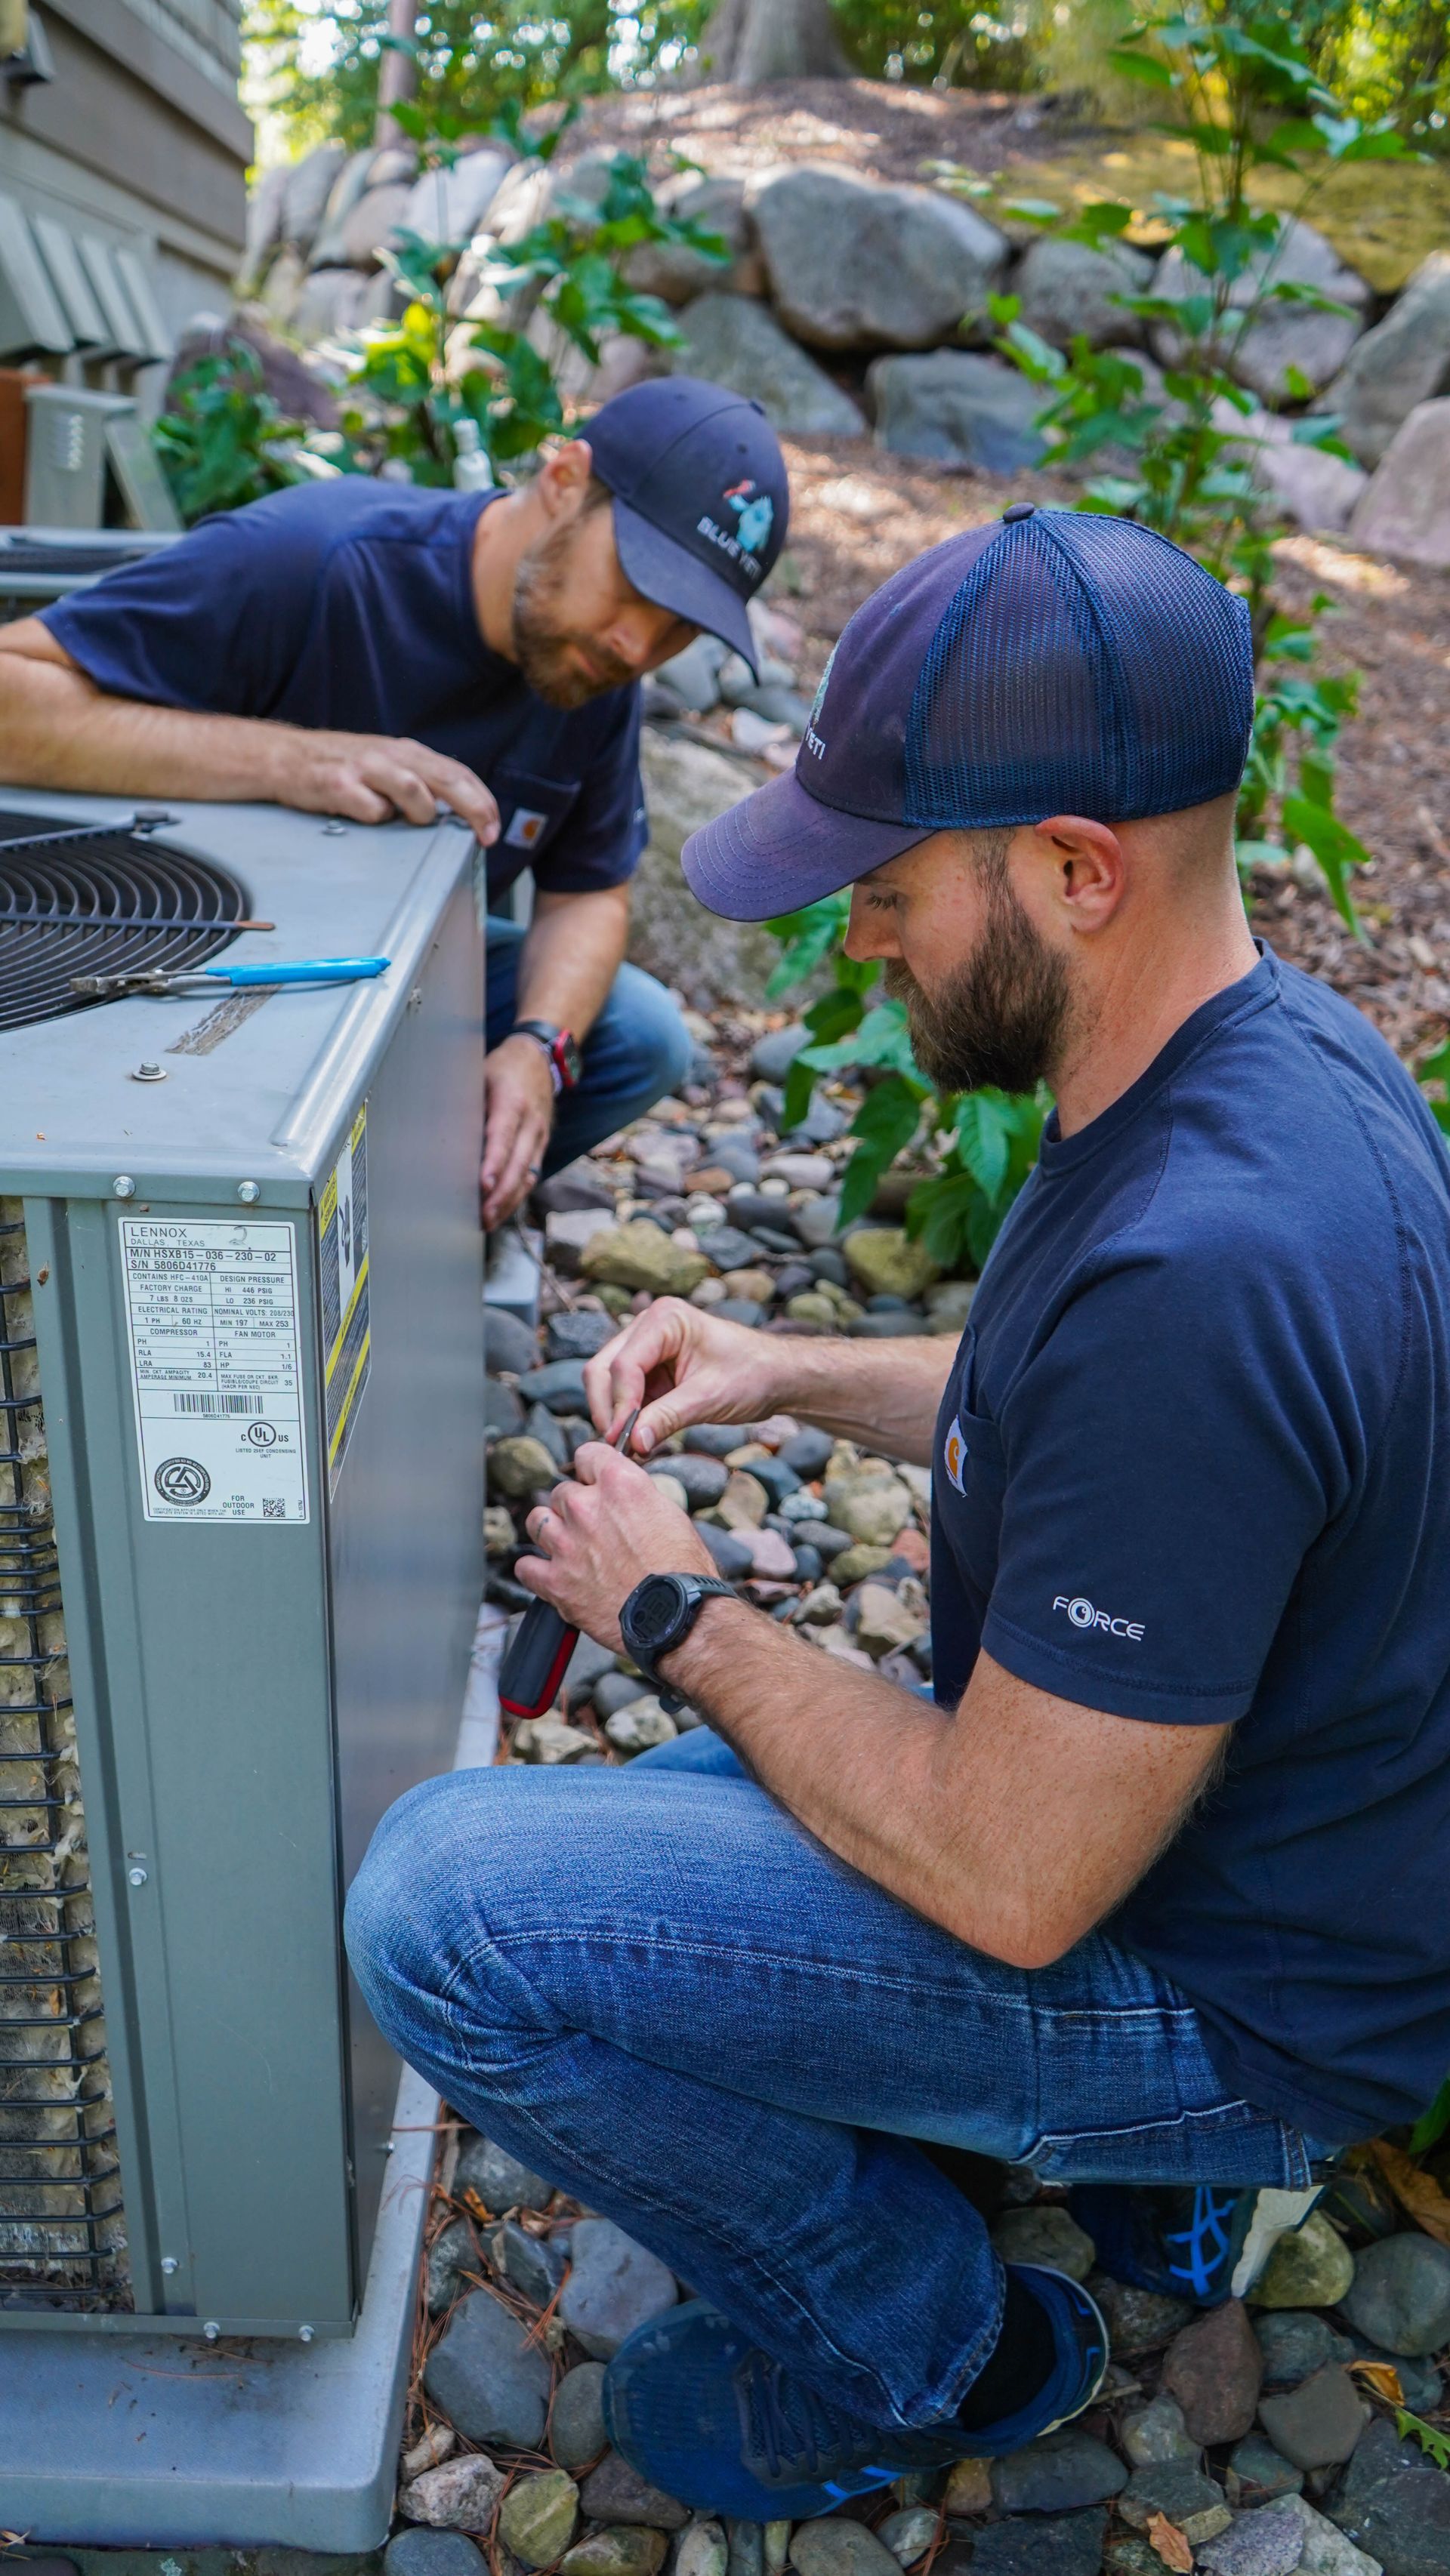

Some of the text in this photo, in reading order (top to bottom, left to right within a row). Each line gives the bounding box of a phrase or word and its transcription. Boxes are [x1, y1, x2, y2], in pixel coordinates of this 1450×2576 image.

[697, 516, 742, 558] BLUE
[131, 1227, 187, 1237] LENNOX
[130, 1249, 150, 1258] M/N
[131, 1260, 216, 1271] S/N 5806D41776
[255, 1427, 270, 1441] UL
[1053, 1596, 1146, 1641] FORCE
